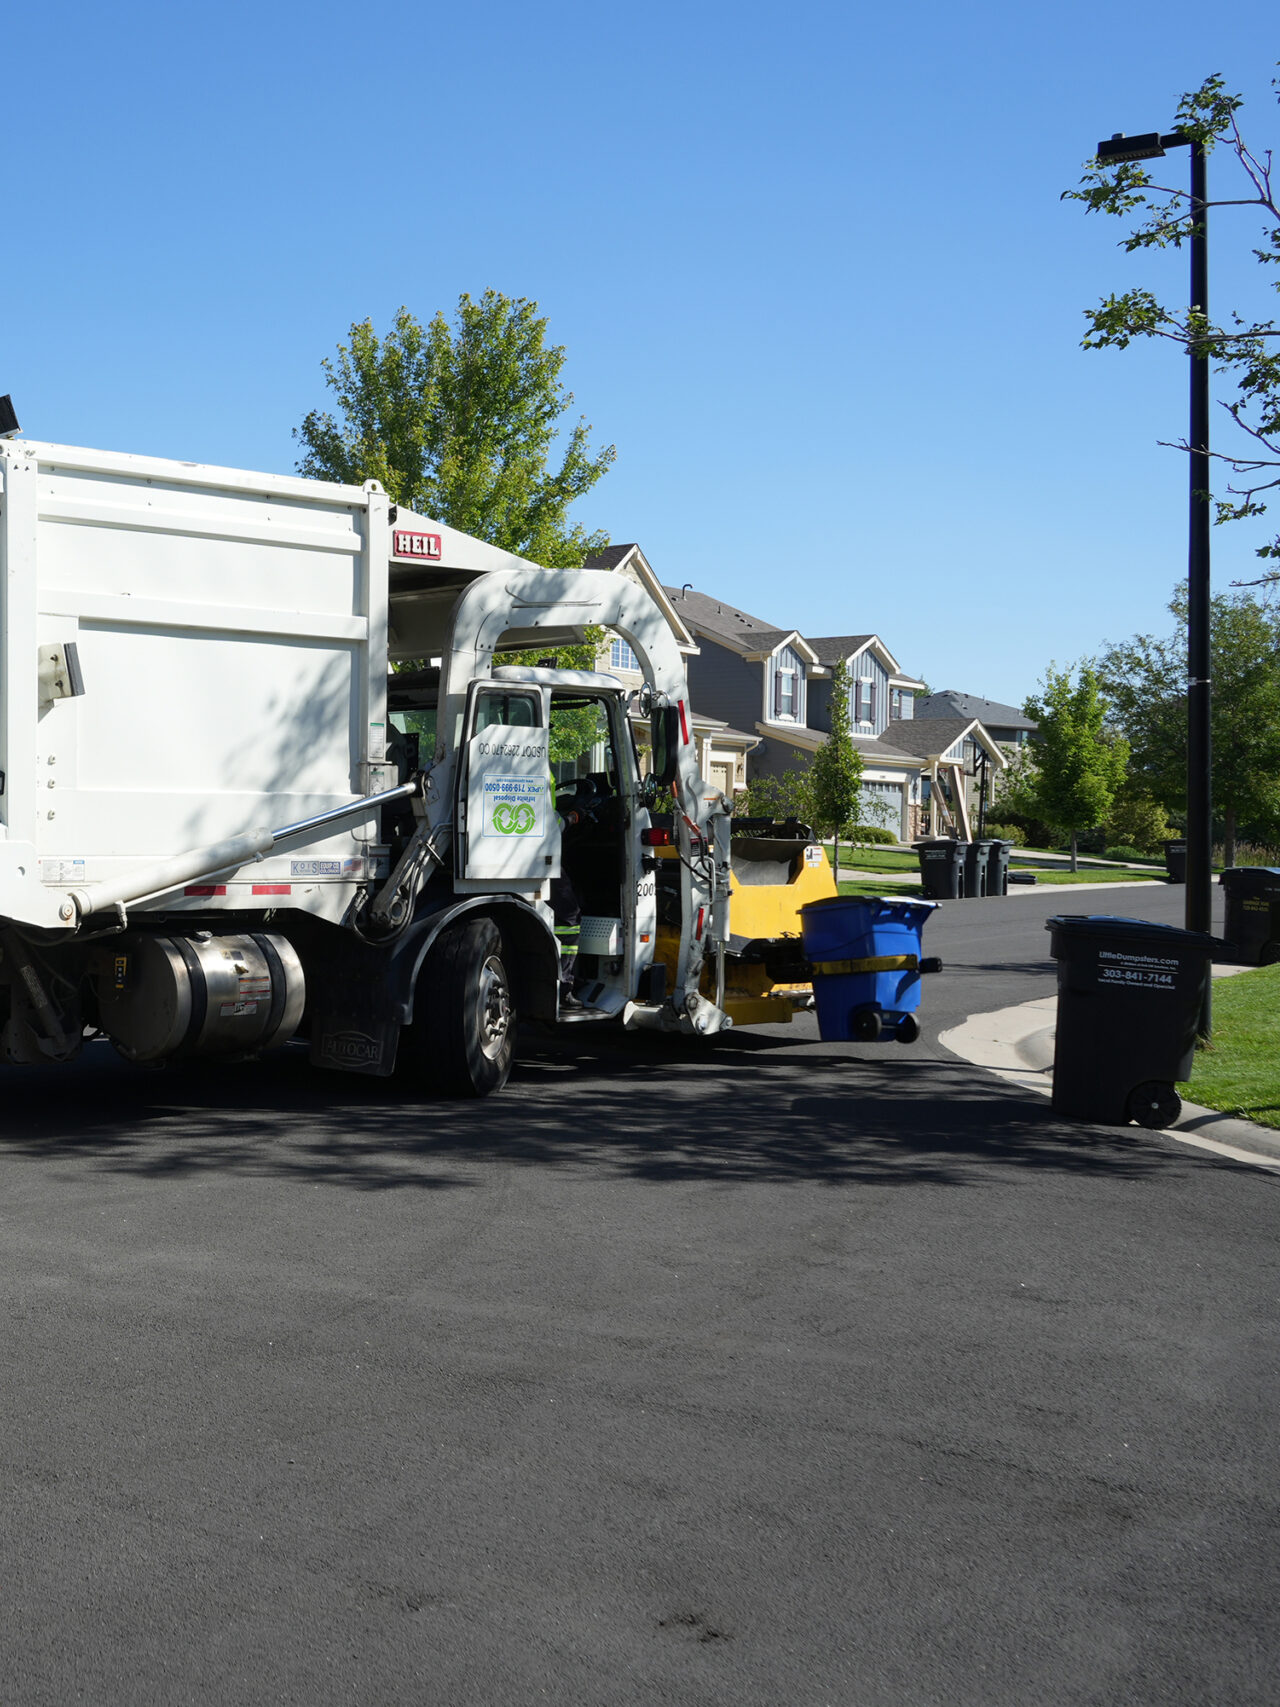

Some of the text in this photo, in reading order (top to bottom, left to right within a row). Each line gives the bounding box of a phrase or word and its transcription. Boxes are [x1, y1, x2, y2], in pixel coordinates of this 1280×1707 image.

[397, 534, 440, 556] HEIL
[479, 743, 490, 756] CO
[521, 744, 546, 758] USDOT
[485, 783, 525, 793] 719-999-0500
[1099, 951, 1179, 965] LittleDumpsters.com
[1103, 969, 1172, 983] 303-841-7144
